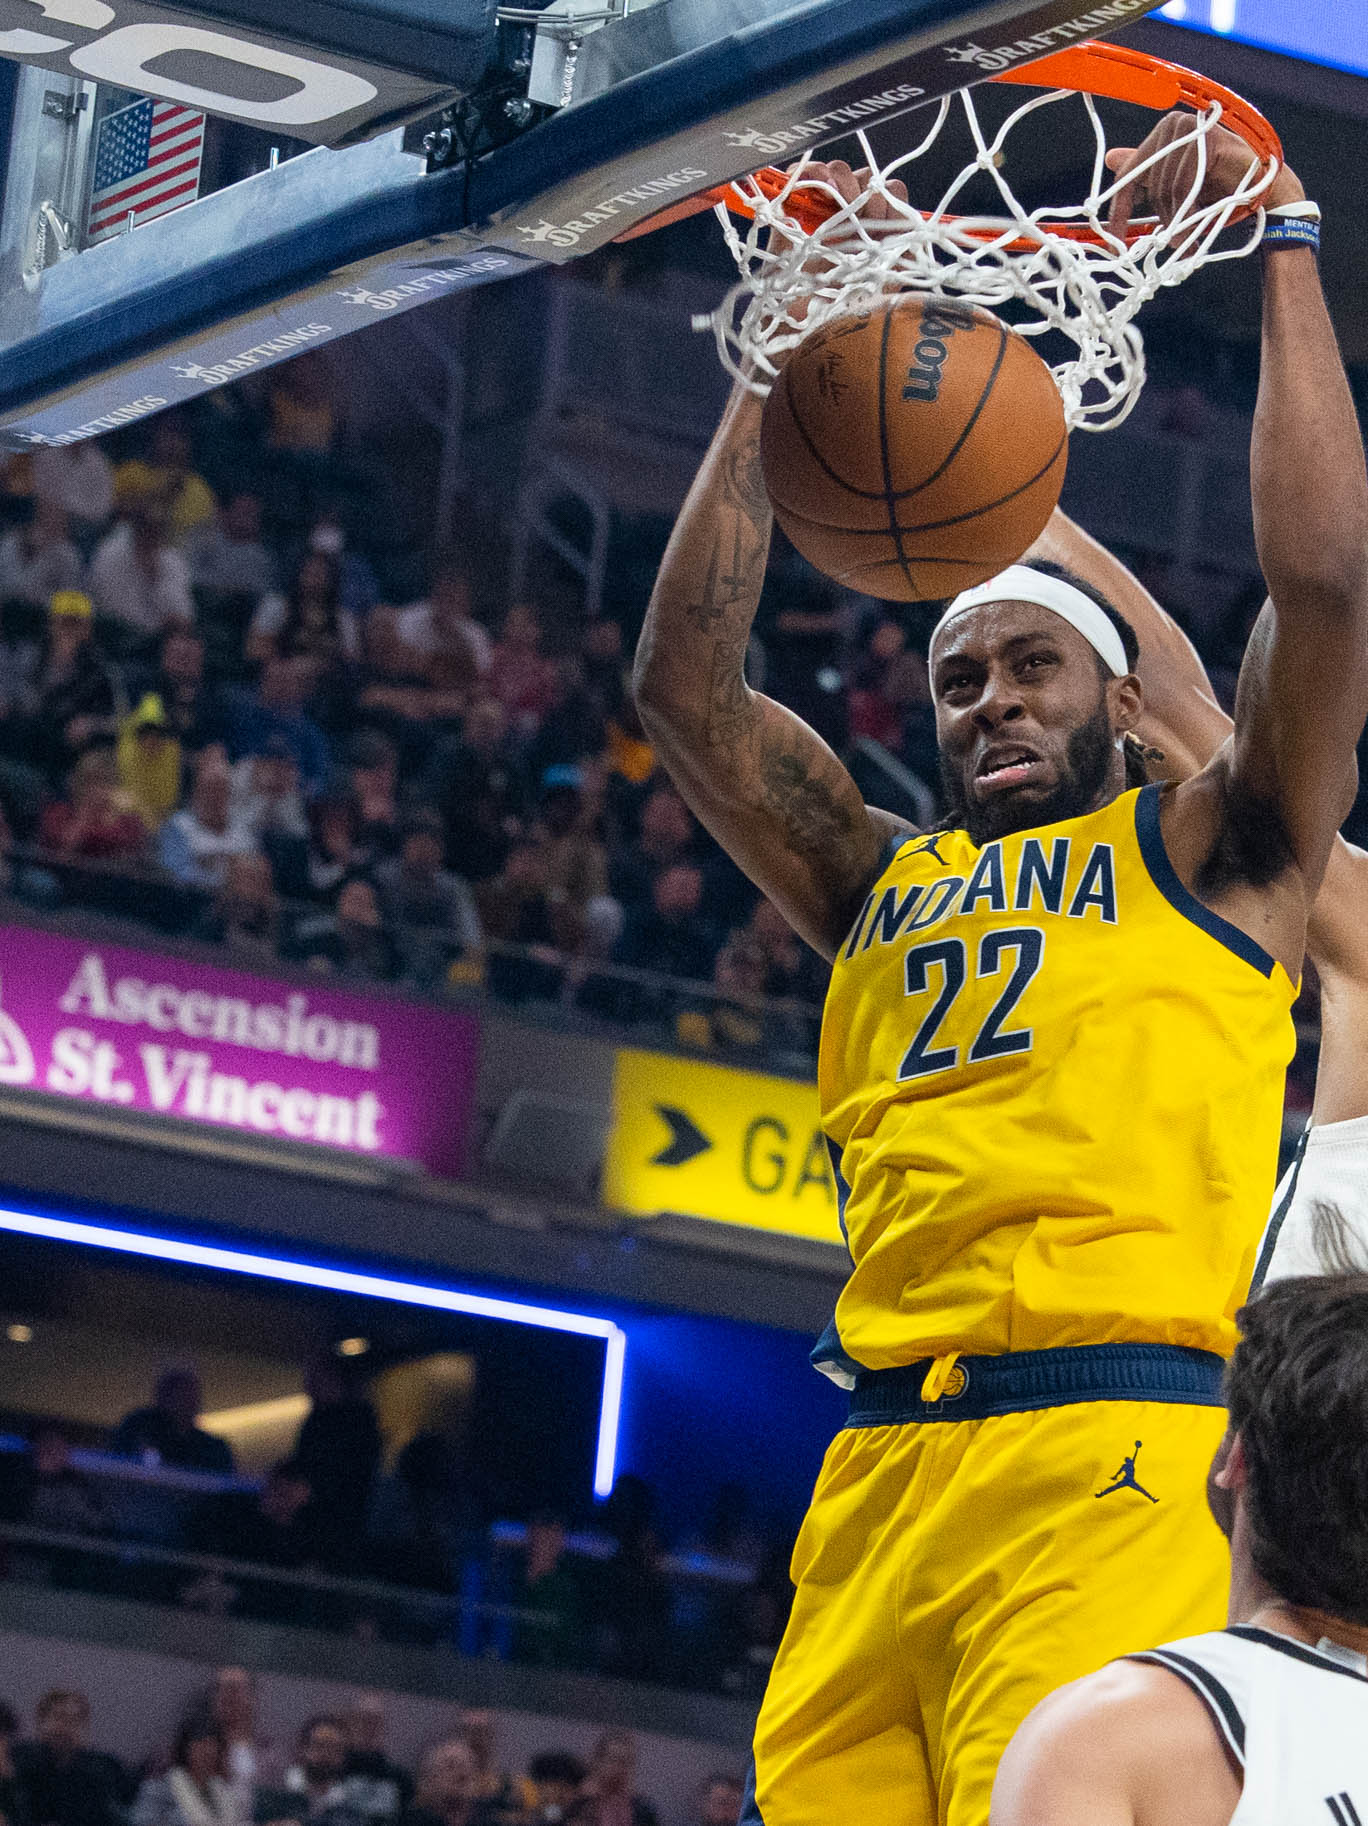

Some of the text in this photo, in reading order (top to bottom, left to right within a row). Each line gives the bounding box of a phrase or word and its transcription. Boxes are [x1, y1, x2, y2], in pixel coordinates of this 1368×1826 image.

[972, 0, 1156, 70] DRAFTKING
[752, 83, 926, 154] DRAFTKINGS
[545, 166, 708, 248] DRAFTKINGS
[365, 256, 509, 311] DRAFTKINGS
[198, 322, 333, 385] DRAFTKINGS
[60, 953, 381, 1070] Ascension
[896, 926, 1046, 1083] 22
[46, 1027, 385, 1150] St. Vincent
